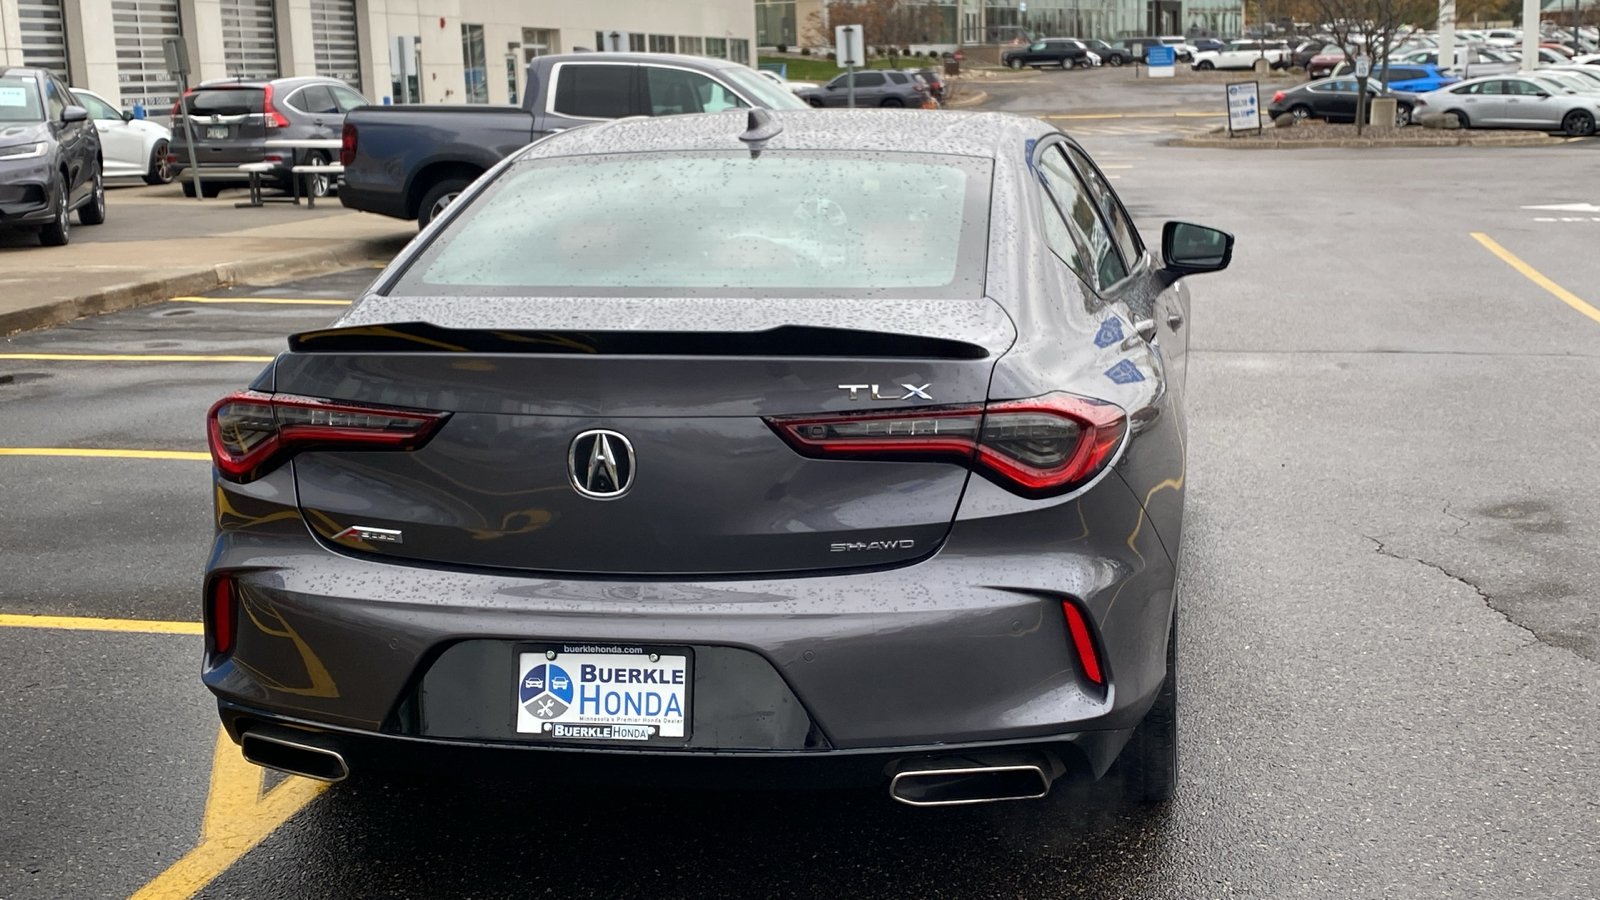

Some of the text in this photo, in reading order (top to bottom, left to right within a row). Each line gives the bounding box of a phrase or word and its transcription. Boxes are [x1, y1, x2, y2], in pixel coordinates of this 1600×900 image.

[838, 383, 933, 400] TLX
[564, 645, 643, 654] buerklehonda.com
[580, 664, 684, 684] BUERKLE
[579, 685, 683, 717] HONDA
